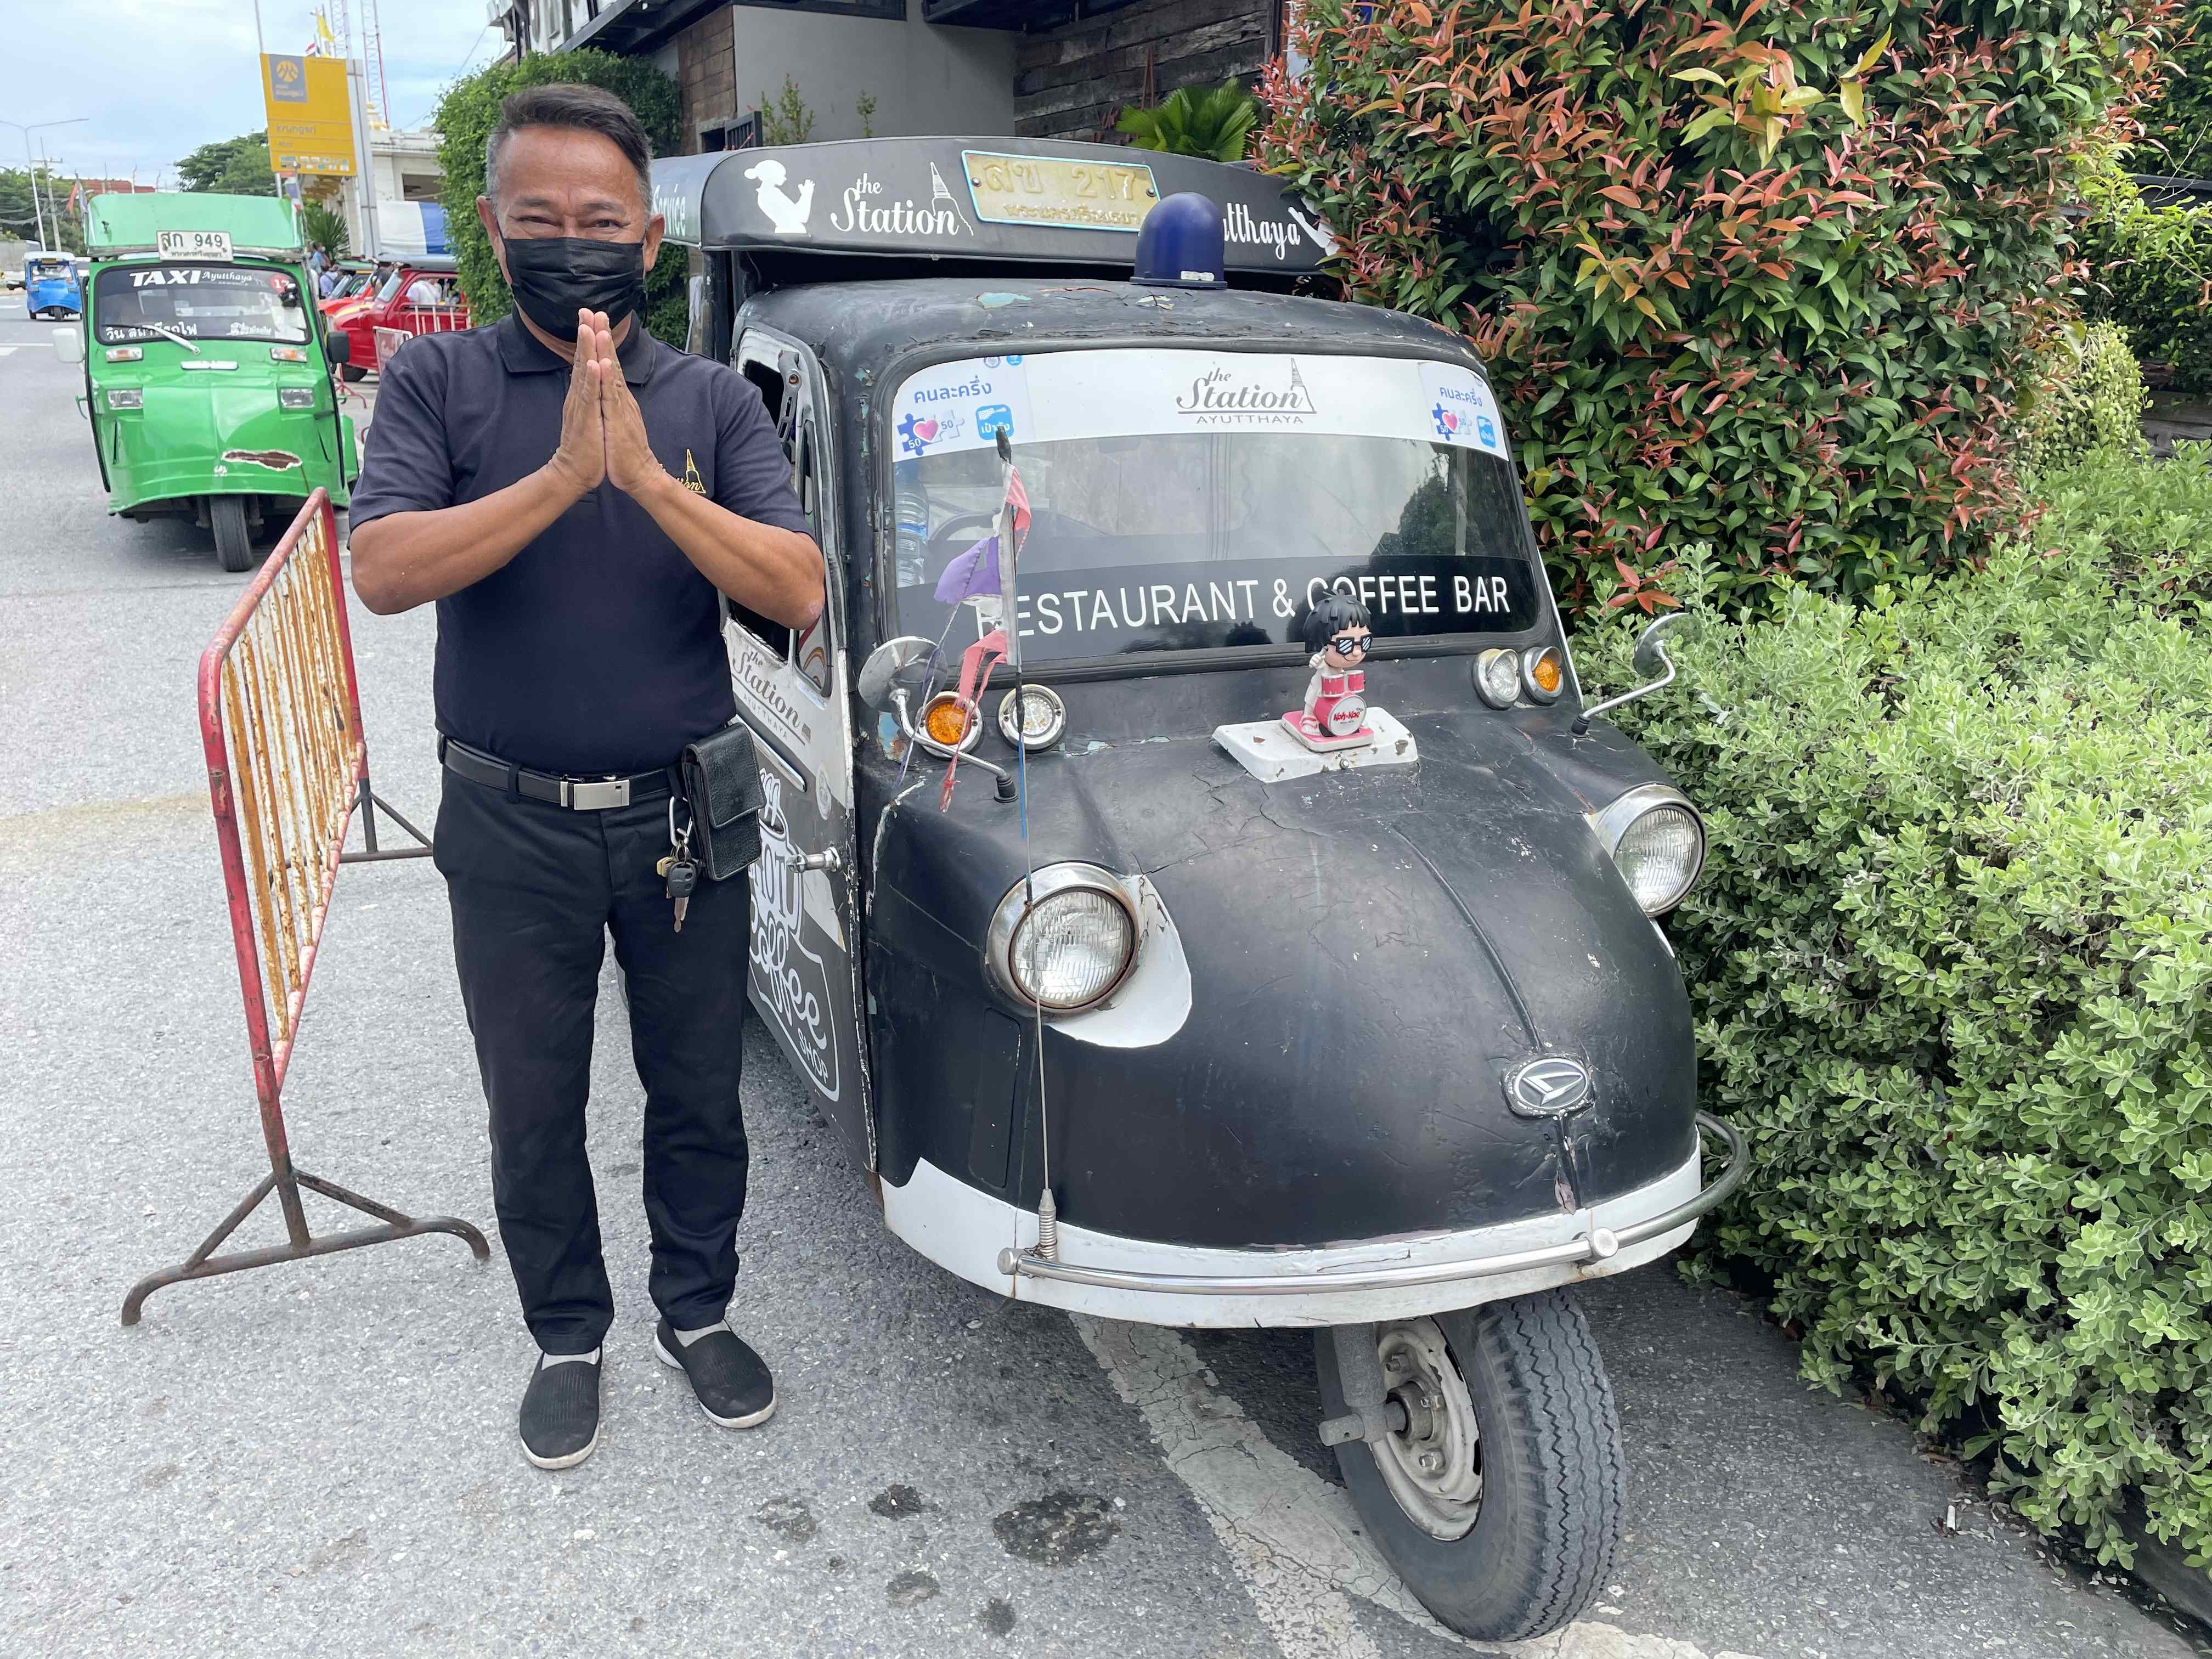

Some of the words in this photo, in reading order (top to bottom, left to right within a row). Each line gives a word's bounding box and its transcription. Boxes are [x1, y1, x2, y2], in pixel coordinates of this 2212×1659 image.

[856, 172, 883, 194] the
[983, 161, 1044, 193] สข
[1071, 166, 1136, 200] 217
[830, 187, 960, 235] Station
[194, 234, 223, 247] 949
[129, 270, 201, 287] TAXI
[202, 271, 252, 283] Ayutthaya
[1208, 367, 1231, 382] the
[915, 375, 992, 404] คนละครึ่ง
[1176, 377, 1304, 409] Station
[941, 420, 953, 430] 50
[1197, 415, 1304, 424] AYUTTHAYA
[1440, 425, 1449, 433] 50
[908, 438, 921, 449] 50
[1272, 578, 1296, 618] &
[1454, 575, 1510, 613] BAR
[746, 650, 764, 668] the
[732, 652, 801, 729] Station
[743, 693, 788, 740] AYUTTHAYA
[797, 1027, 828, 1084] SHOP
